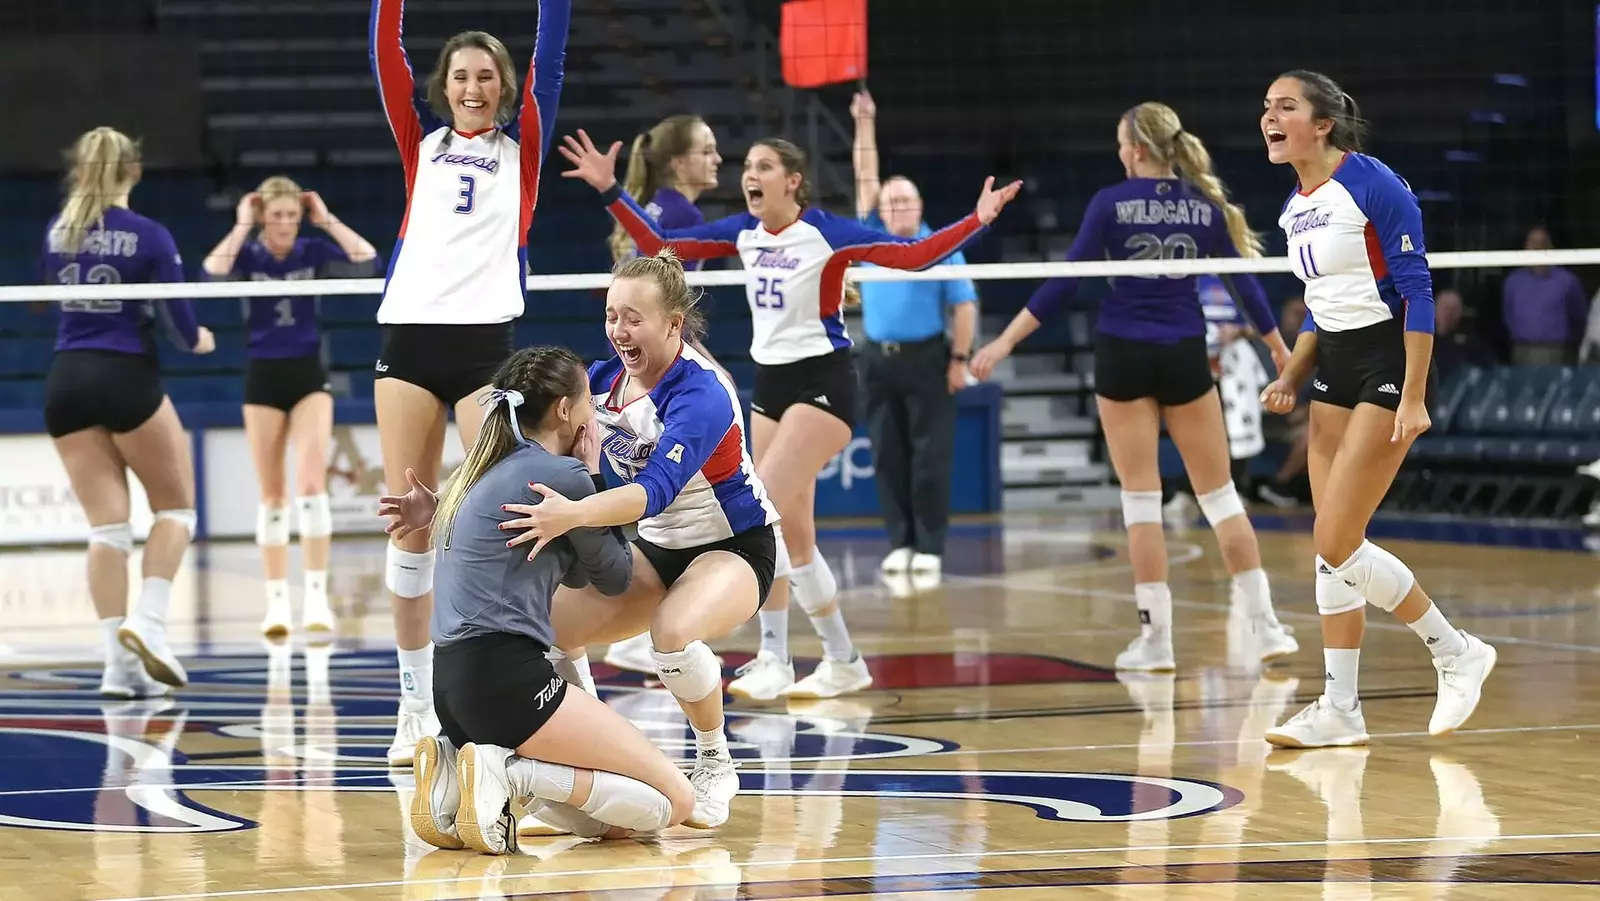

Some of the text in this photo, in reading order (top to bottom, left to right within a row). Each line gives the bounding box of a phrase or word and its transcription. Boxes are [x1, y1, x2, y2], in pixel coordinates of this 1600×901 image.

[453, 173, 477, 214] 3
[1115, 198, 1212, 227] WILDCATS
[1289, 207, 1333, 239] Tulsa
[751, 246, 801, 271] Tulsa
[1124, 232, 1198, 280] 20
[1299, 242, 1320, 279] 11
[57, 262, 123, 314] 12
[755, 277, 784, 309] 25
[273, 297, 296, 326] 1
